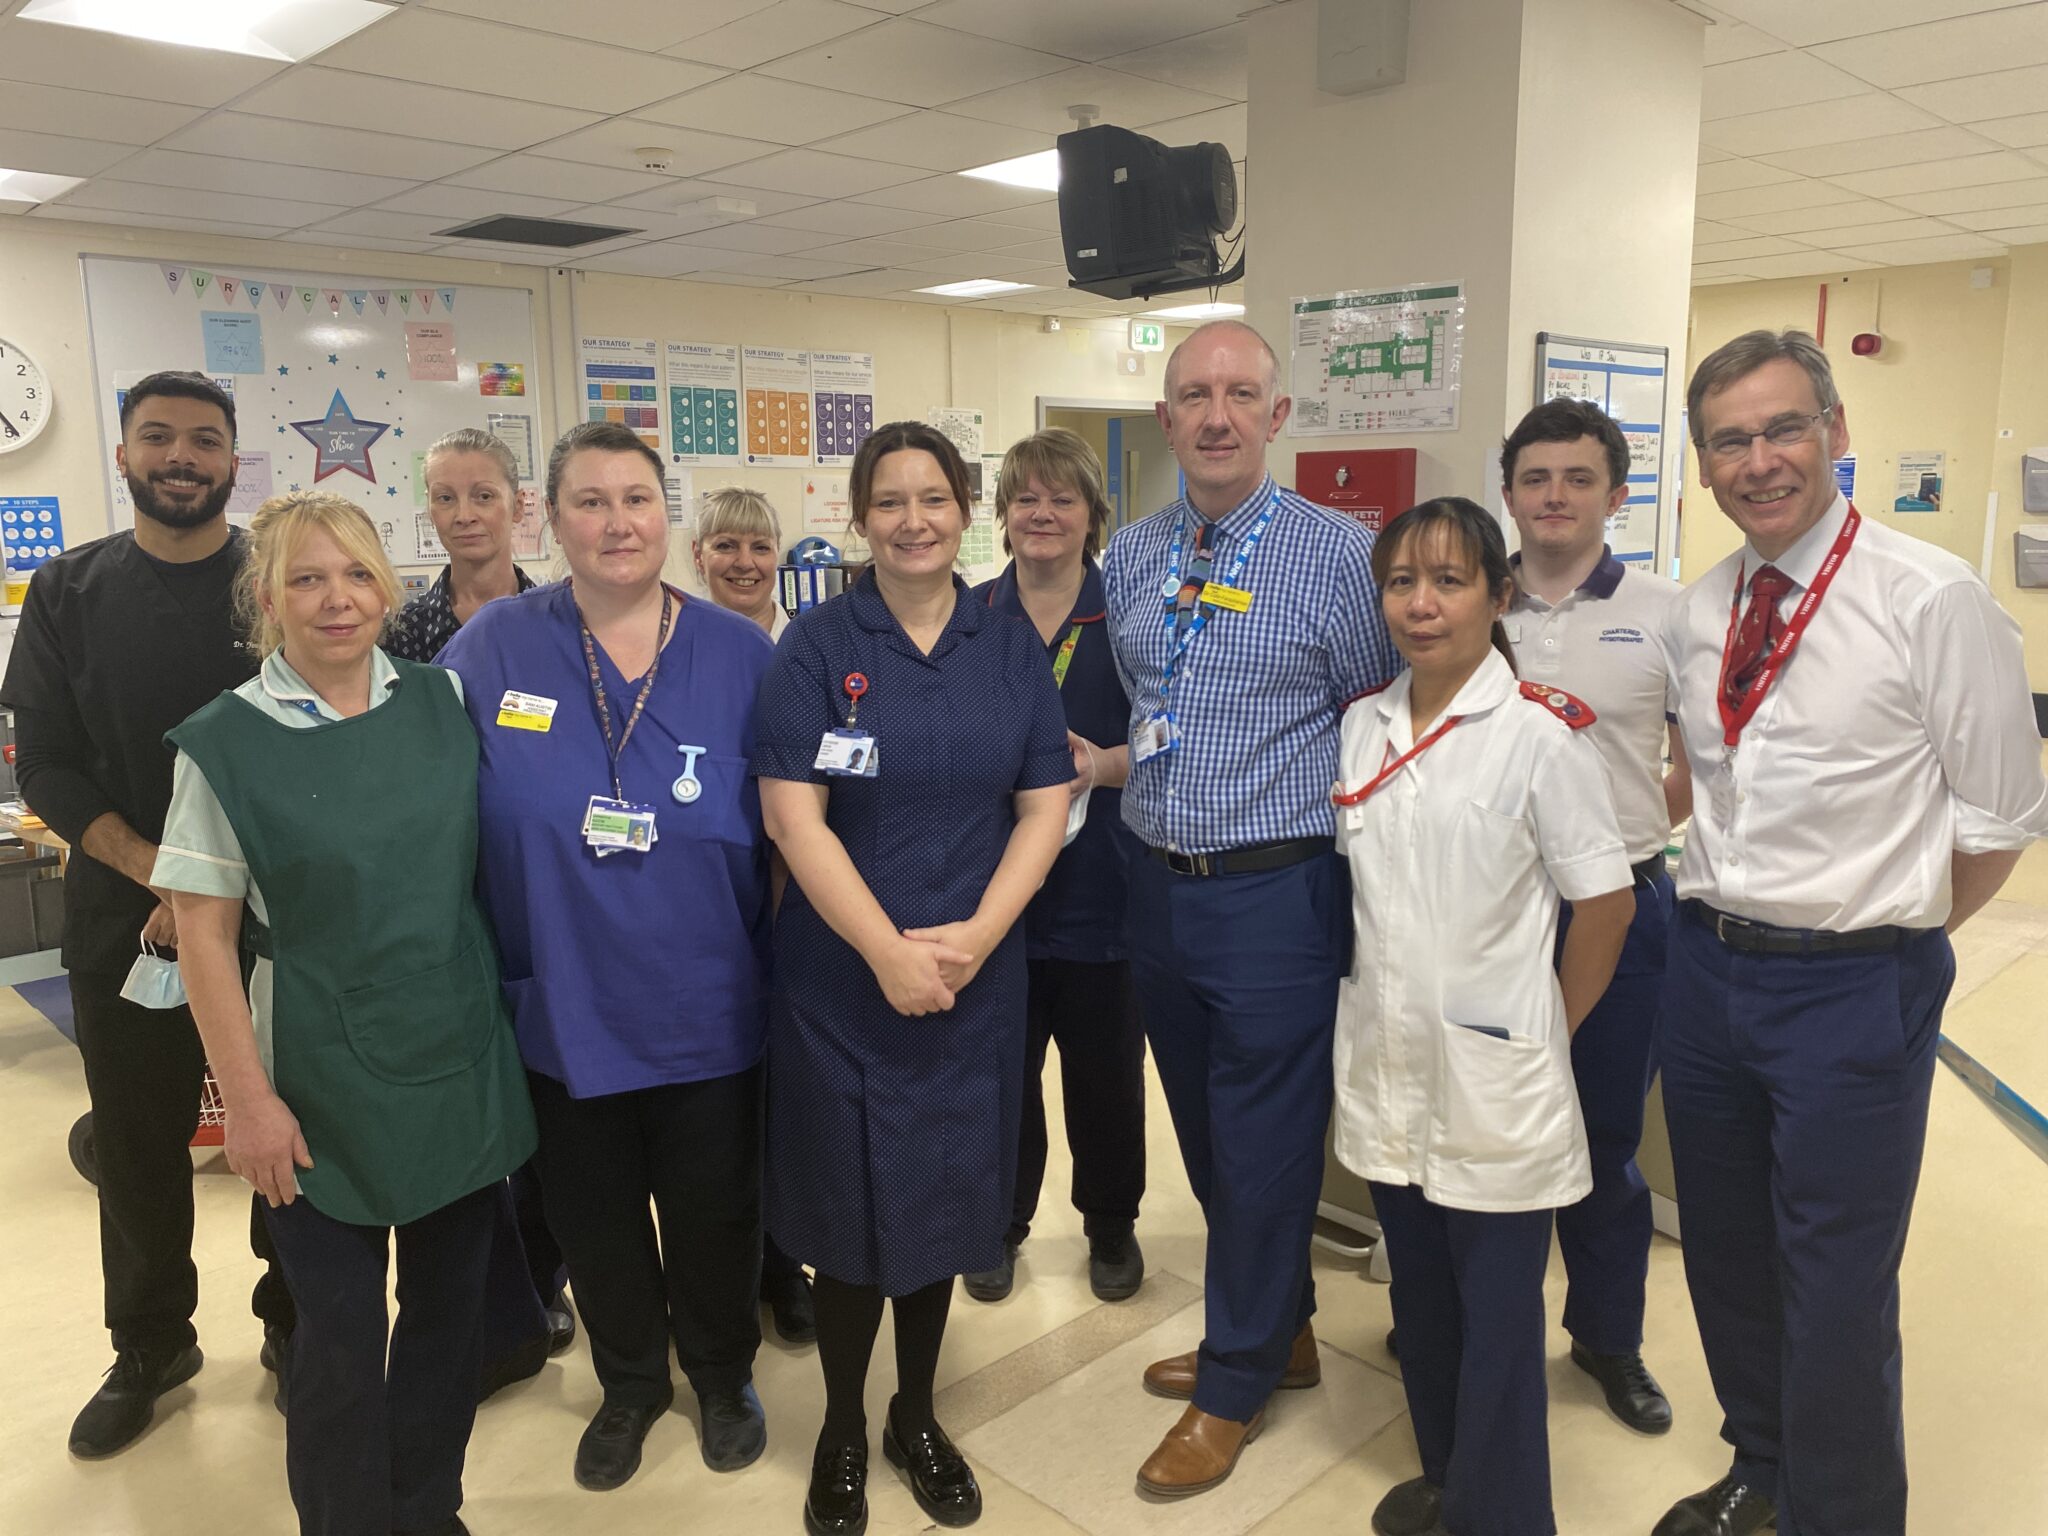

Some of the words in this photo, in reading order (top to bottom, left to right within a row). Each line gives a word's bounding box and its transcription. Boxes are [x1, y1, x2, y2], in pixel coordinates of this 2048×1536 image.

[598, 340, 630, 348] STRATEGY
[682, 345, 711, 353] STRATEGY
[16, 364, 26, 376] 2
[26, 388, 36, 399] 3
[20, 410, 30, 422] 4
[329, 435, 355, 453] Shine
[1265, 502, 1277, 517] NHS
[1252, 520, 1266, 537] NHS
[1843, 518, 1855, 537] VISITOR
[1241, 540, 1254, 558] NHS
[1229, 560, 1242, 578] NHS
[1822, 553, 1839, 576] VISITOR
[1800, 592, 1817, 615] VISITOR
[1182, 626, 1196, 644] NHS
[1778, 631, 1795, 654] VISITOR
[1754, 669, 1770, 691] VISITOR
